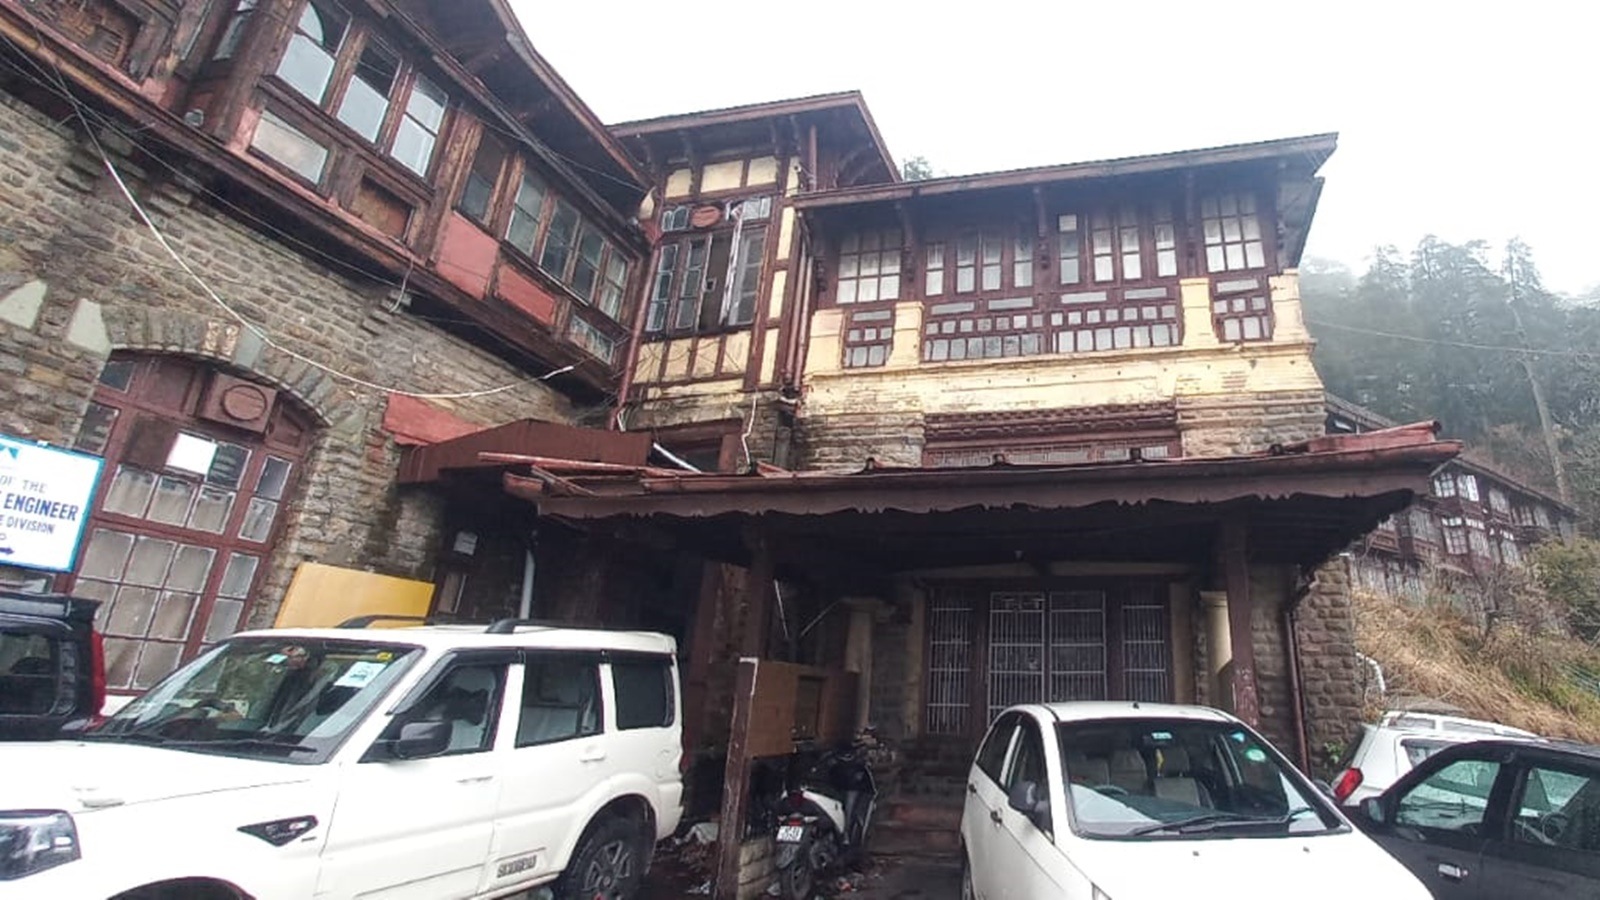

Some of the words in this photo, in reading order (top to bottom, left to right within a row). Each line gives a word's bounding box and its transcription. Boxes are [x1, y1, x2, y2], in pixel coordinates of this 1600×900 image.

[22, 479, 47, 494] THE
[3, 492, 79, 521] ENGINEER
[6, 515, 56, 535] DIVISION
